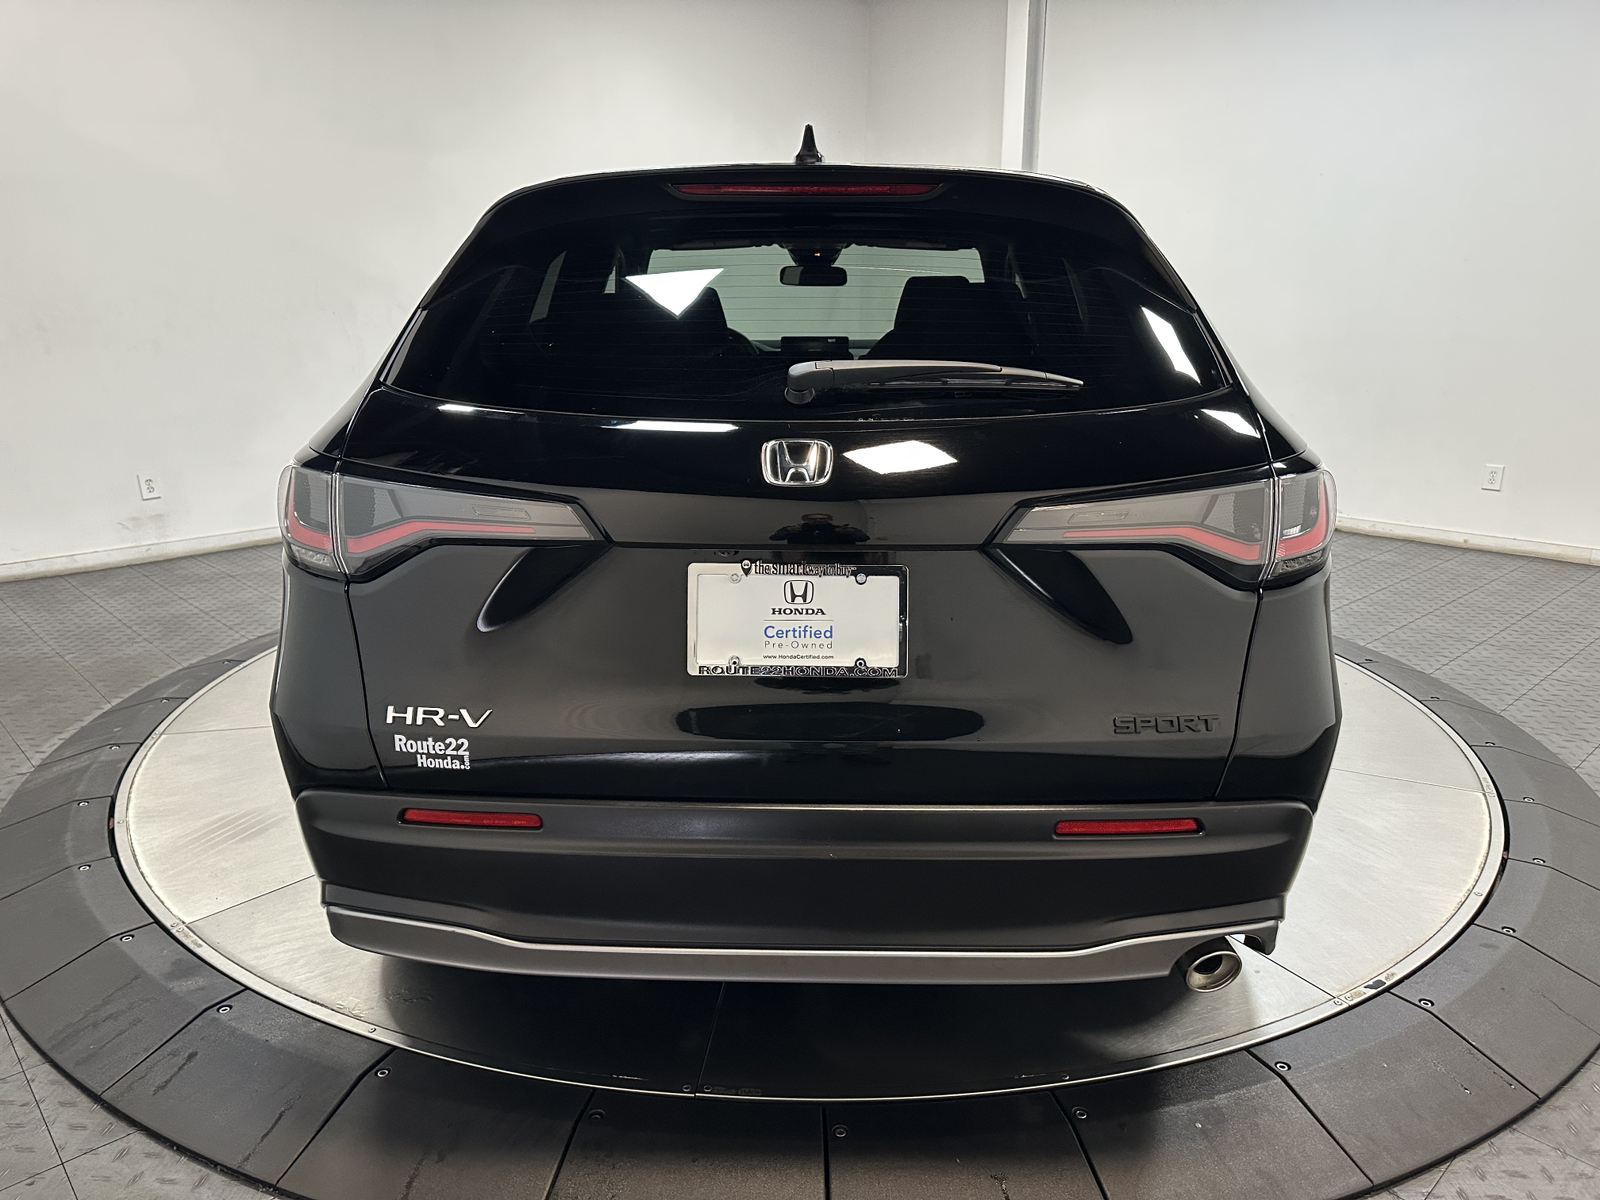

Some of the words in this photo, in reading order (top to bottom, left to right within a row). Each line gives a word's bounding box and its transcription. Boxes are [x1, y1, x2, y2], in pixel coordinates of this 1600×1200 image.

[771, 608, 826, 616] HONDA
[764, 625, 833, 639] Certified
[764, 641, 833, 649] Pre-Owned
[698, 666, 897, 678] ROUTE22HONDA.COM
[386, 706, 493, 728] HR-V
[1113, 714, 1219, 734] SPORT
[394, 734, 469, 755] Route22
